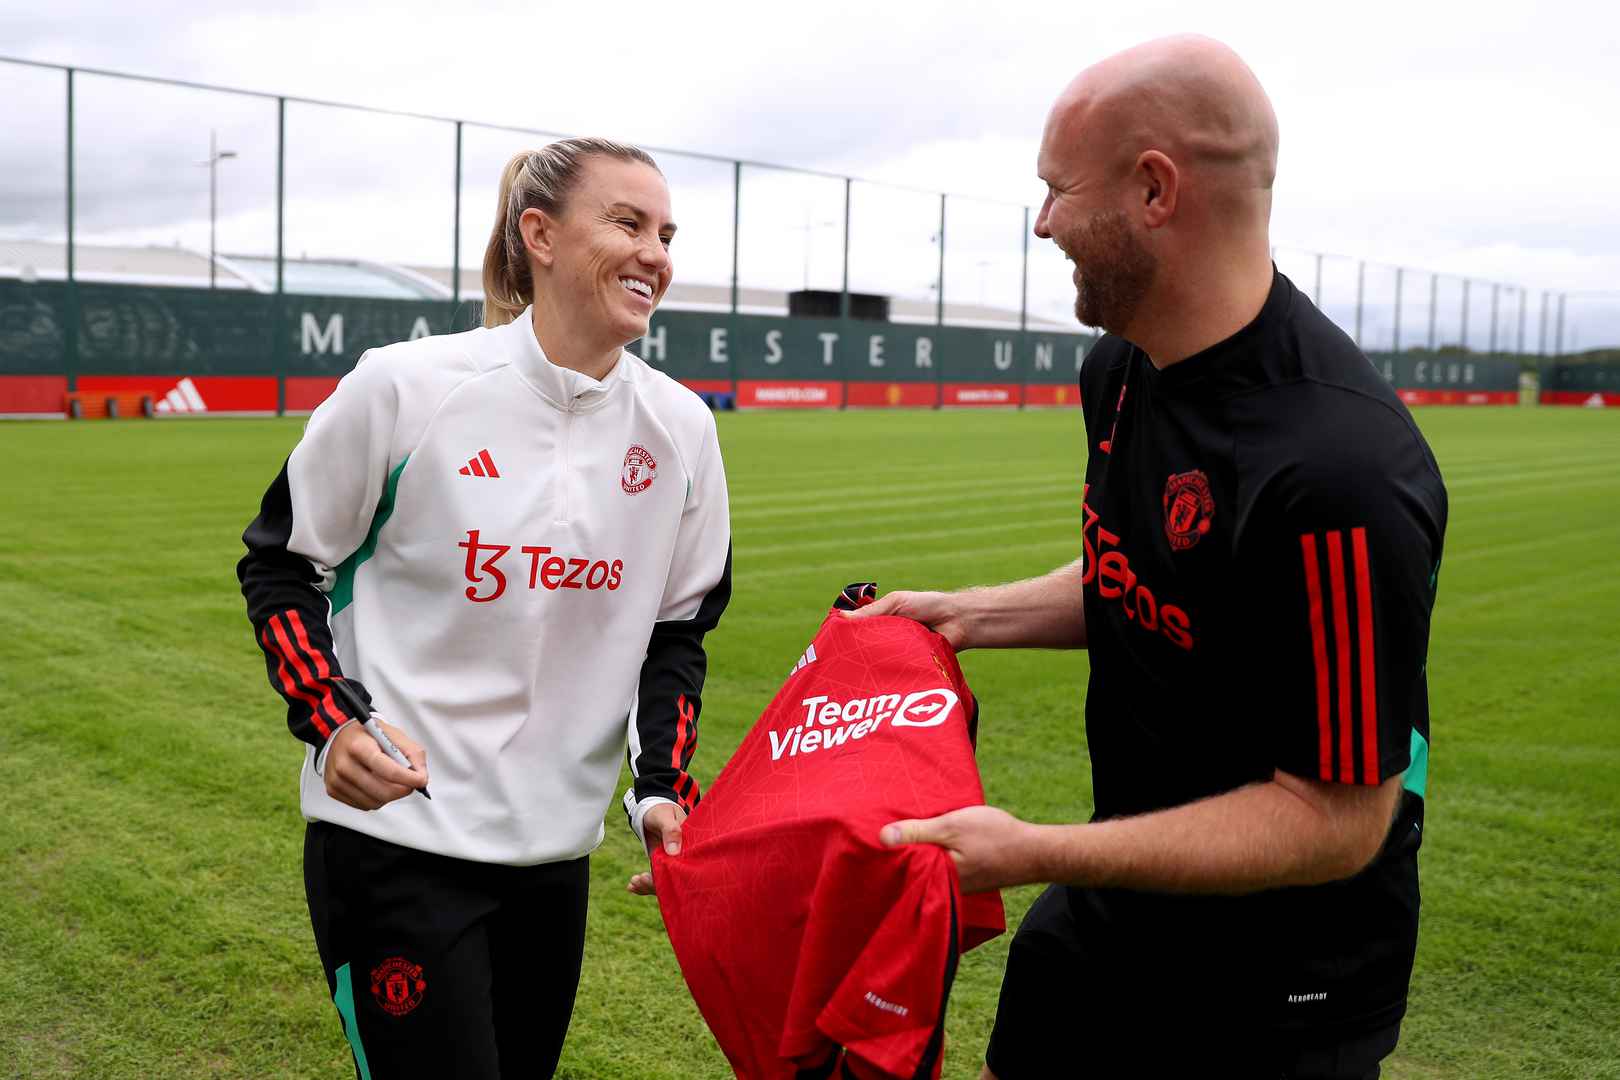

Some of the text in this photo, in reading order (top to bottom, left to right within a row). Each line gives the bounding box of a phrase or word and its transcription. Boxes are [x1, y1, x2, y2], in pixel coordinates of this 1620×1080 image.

[301, 312, 933, 367] MAHESTER
[994, 339, 1085, 371] UNI
[624, 447, 655, 467] CHESTER
[521, 546, 624, 591] Tezos
[802, 694, 902, 728] Team
[768, 711, 893, 761] Viewer
